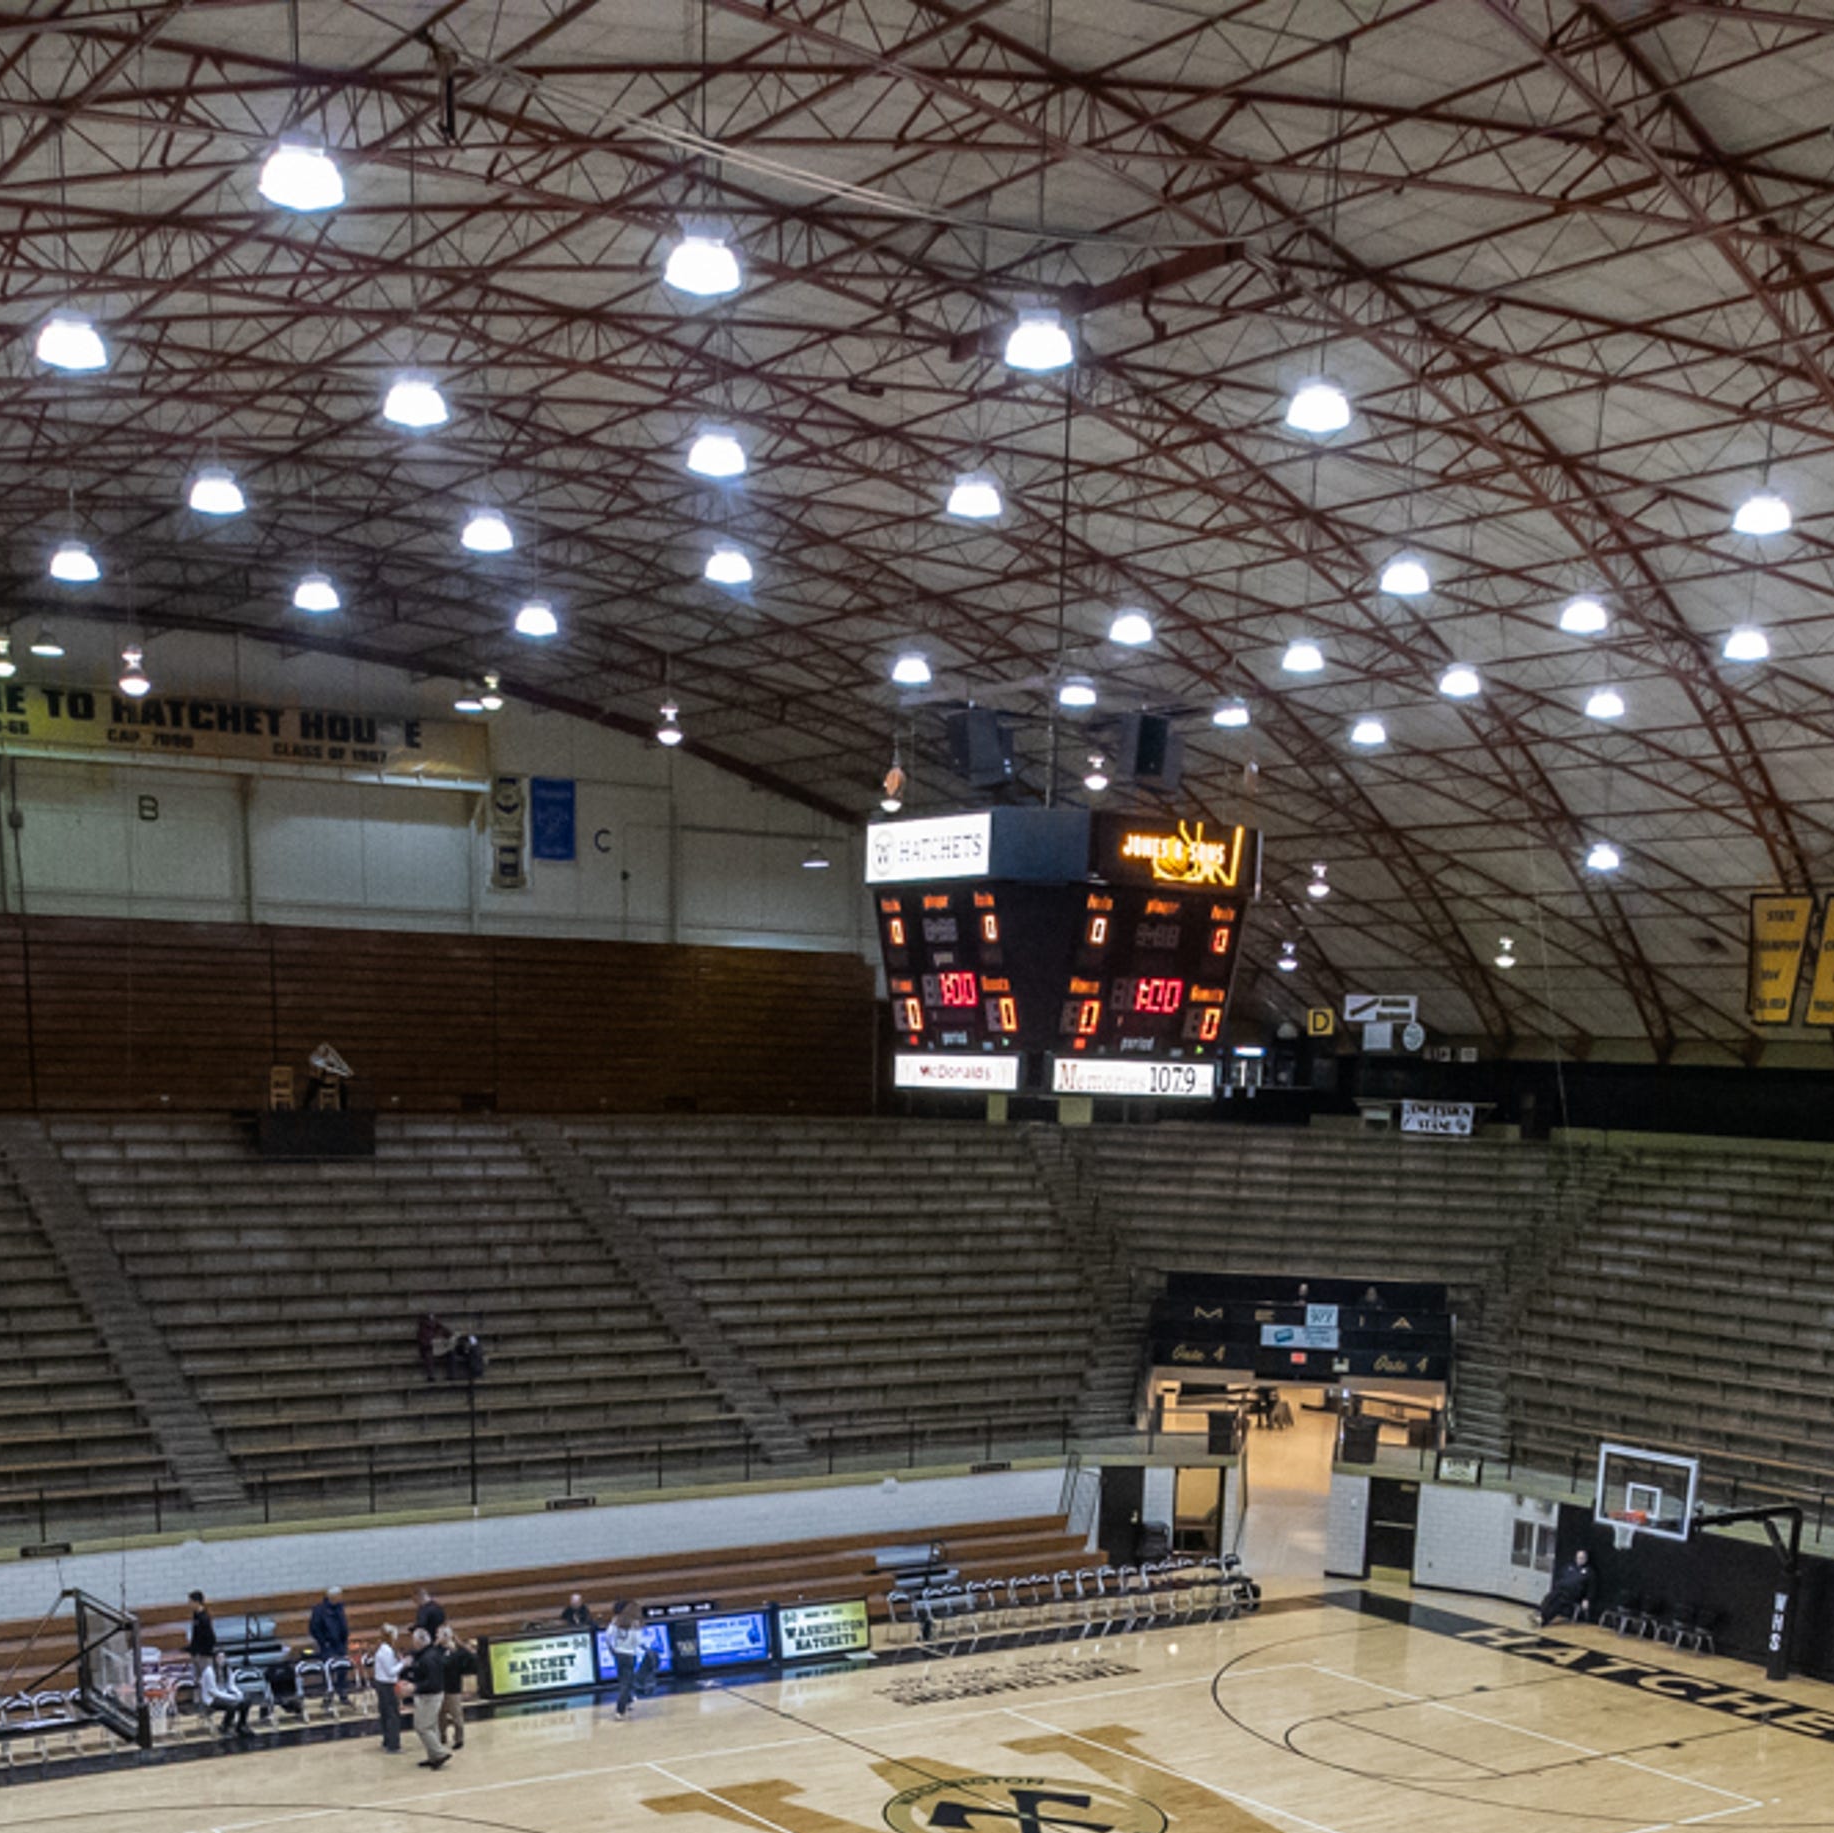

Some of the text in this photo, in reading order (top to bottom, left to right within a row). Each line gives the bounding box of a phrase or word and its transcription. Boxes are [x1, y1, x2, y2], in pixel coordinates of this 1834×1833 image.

[42, 688, 94, 719] TO
[112, 693, 283, 736] HATCHET
[300, 711, 421, 748] HOUE
[138, 794, 160, 821] B
[595, 828, 612, 853] C
[1312, 1011, 1330, 1033] D
[784, 1619, 865, 1640] WASHINGTON
[1767, 1591, 1790, 1652] WHS
[795, 1632, 859, 1652] HATCHETS
[509, 1654, 577, 1673] HATCHET
[521, 1670, 568, 1686] HOUSE
